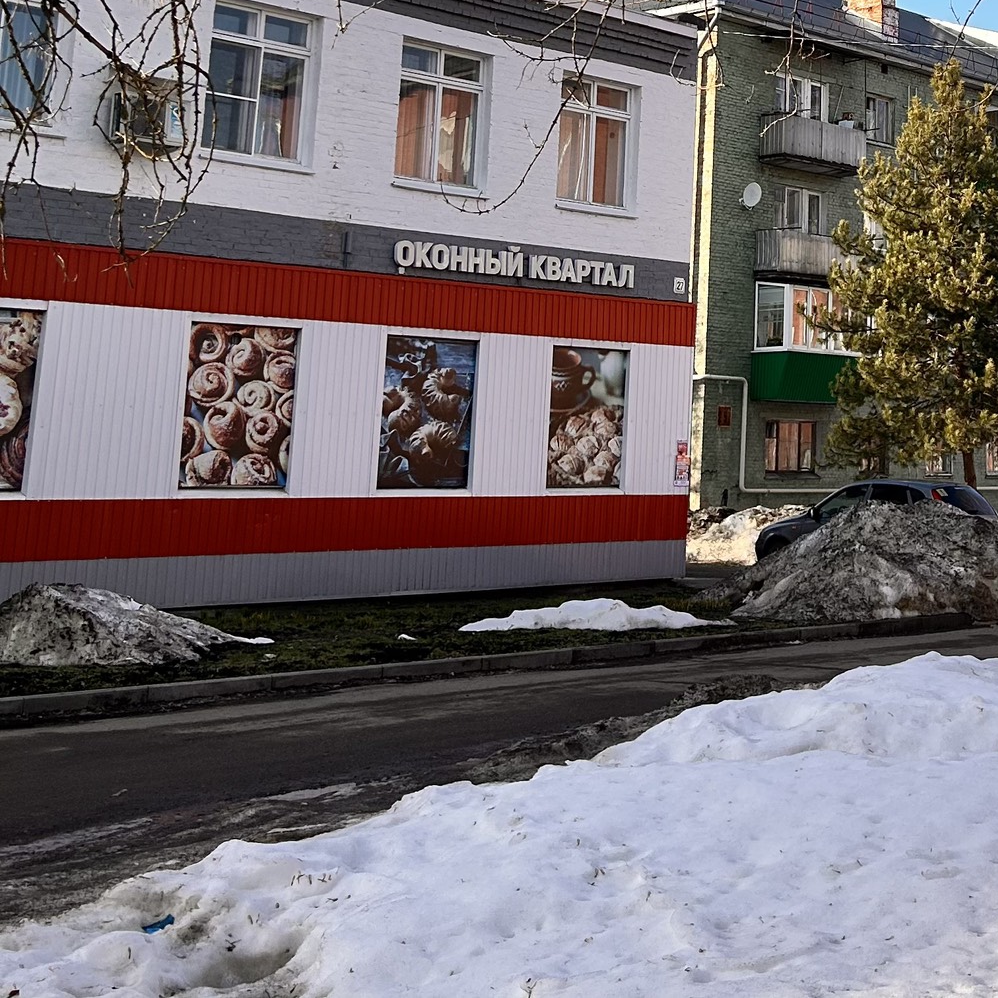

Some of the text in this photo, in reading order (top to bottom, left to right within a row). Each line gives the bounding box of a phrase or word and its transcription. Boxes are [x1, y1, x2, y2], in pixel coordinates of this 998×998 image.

[394, 240, 635, 289] ОКОННЫЙ КВАРТАЛ
[676, 280, 684, 291] 27
